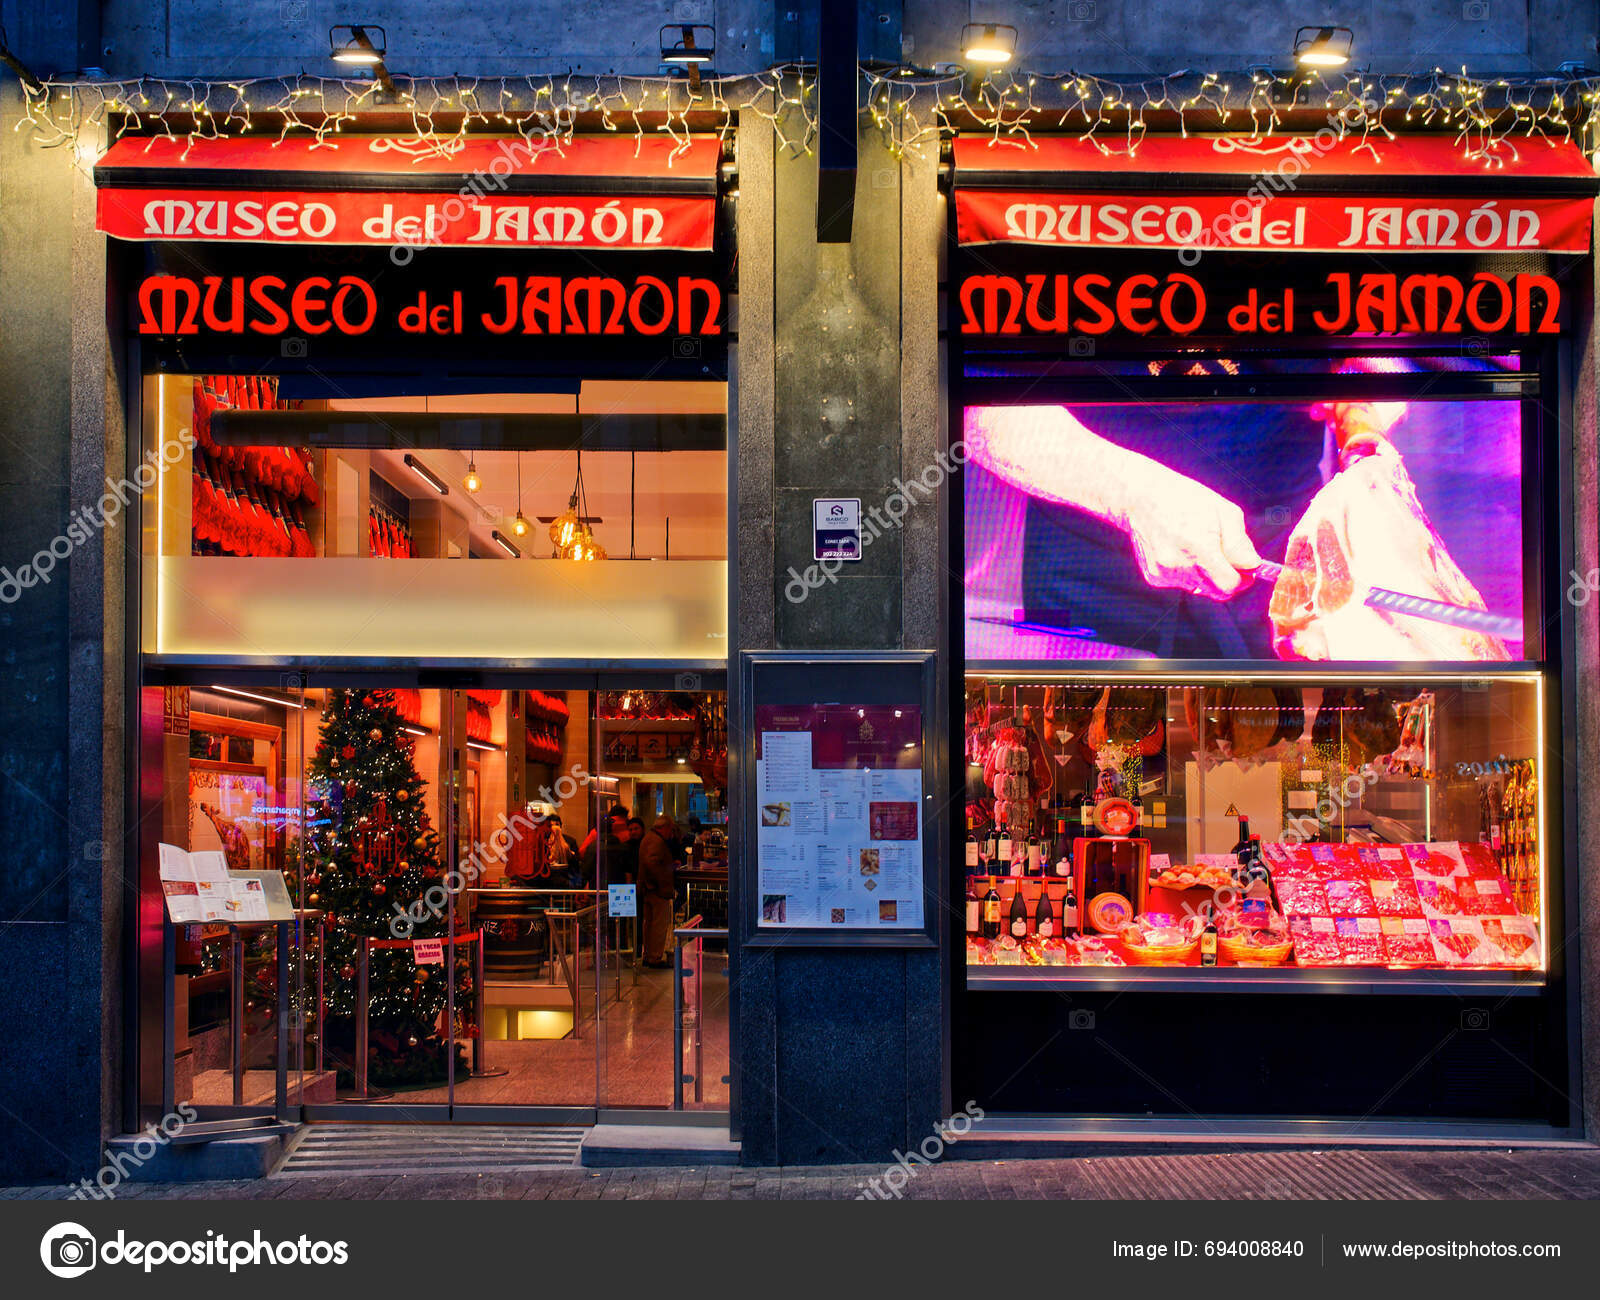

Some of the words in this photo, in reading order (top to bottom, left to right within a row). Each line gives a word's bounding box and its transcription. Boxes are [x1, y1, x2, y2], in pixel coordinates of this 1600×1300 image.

[143, 199, 337, 238] MUSEO
[362, 203, 436, 241] del
[467, 199, 665, 244] JAMÓN
[1005, 203, 1203, 244] MUSEO
[1231, 206, 1306, 246] del
[1338, 201, 1541, 248] JAMÓN
[138, 275, 378, 335] MUSEO
[398, 291, 463, 334] del
[481, 276, 721, 335] JAMON
[959, 273, 1207, 334] MUSEO
[1227, 288, 1294, 333] del
[1313, 272, 1561, 334] JAMON
